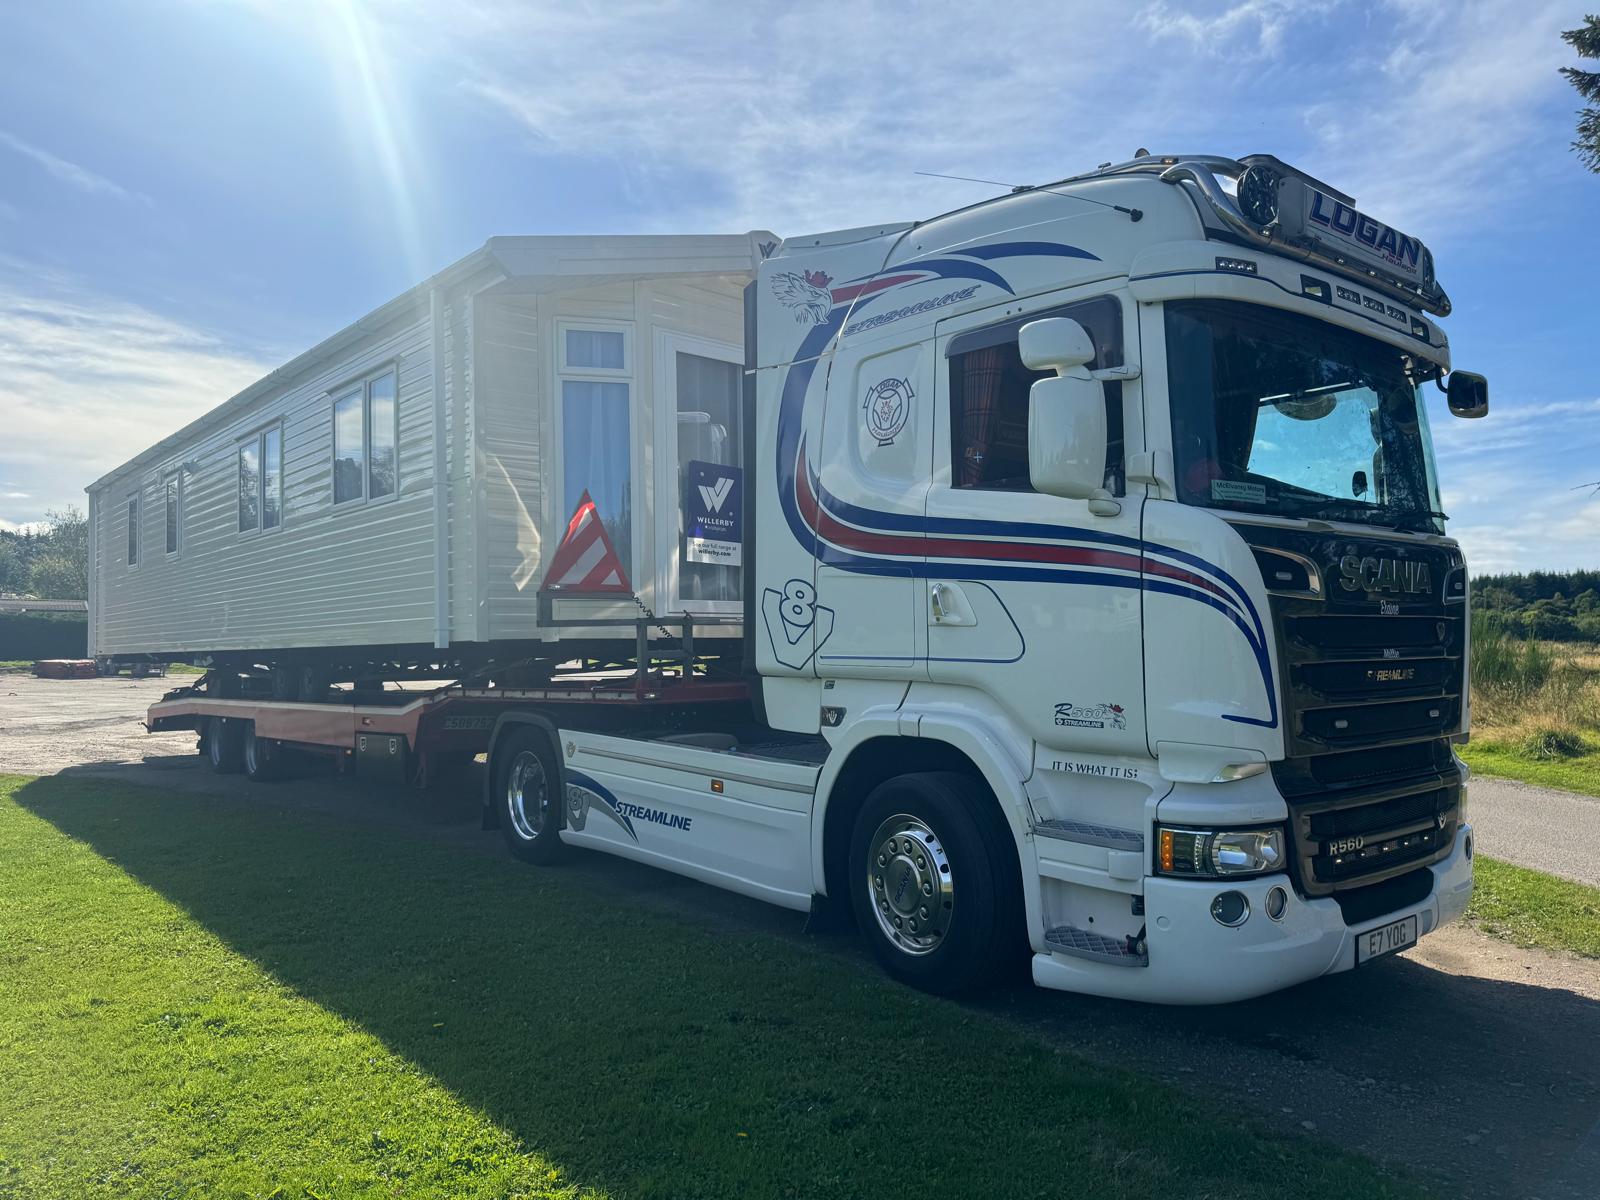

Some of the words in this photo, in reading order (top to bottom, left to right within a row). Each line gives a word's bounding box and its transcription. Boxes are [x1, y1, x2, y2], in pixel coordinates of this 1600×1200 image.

[1309, 191, 1420, 267] LOGAN
[697, 516, 735, 527] WILLERBY
[698, 549, 732, 557] willerby.com
[1339, 555, 1433, 594] SCANIA
[1054, 703, 1103, 719] R560
[1064, 720, 1102, 729] STREAMLINE
[1052, 761, 1062, 770] IT
[1064, 762, 1073, 772] IS
[1076, 763, 1108, 776] WHAT
[1110, 767, 1120, 777] IT
[615, 801, 692, 831] STREAMLINE
[1329, 836, 1364, 856] R560
[1369, 931, 1383, 956] E7
[1386, 922, 1406, 949] YOG
